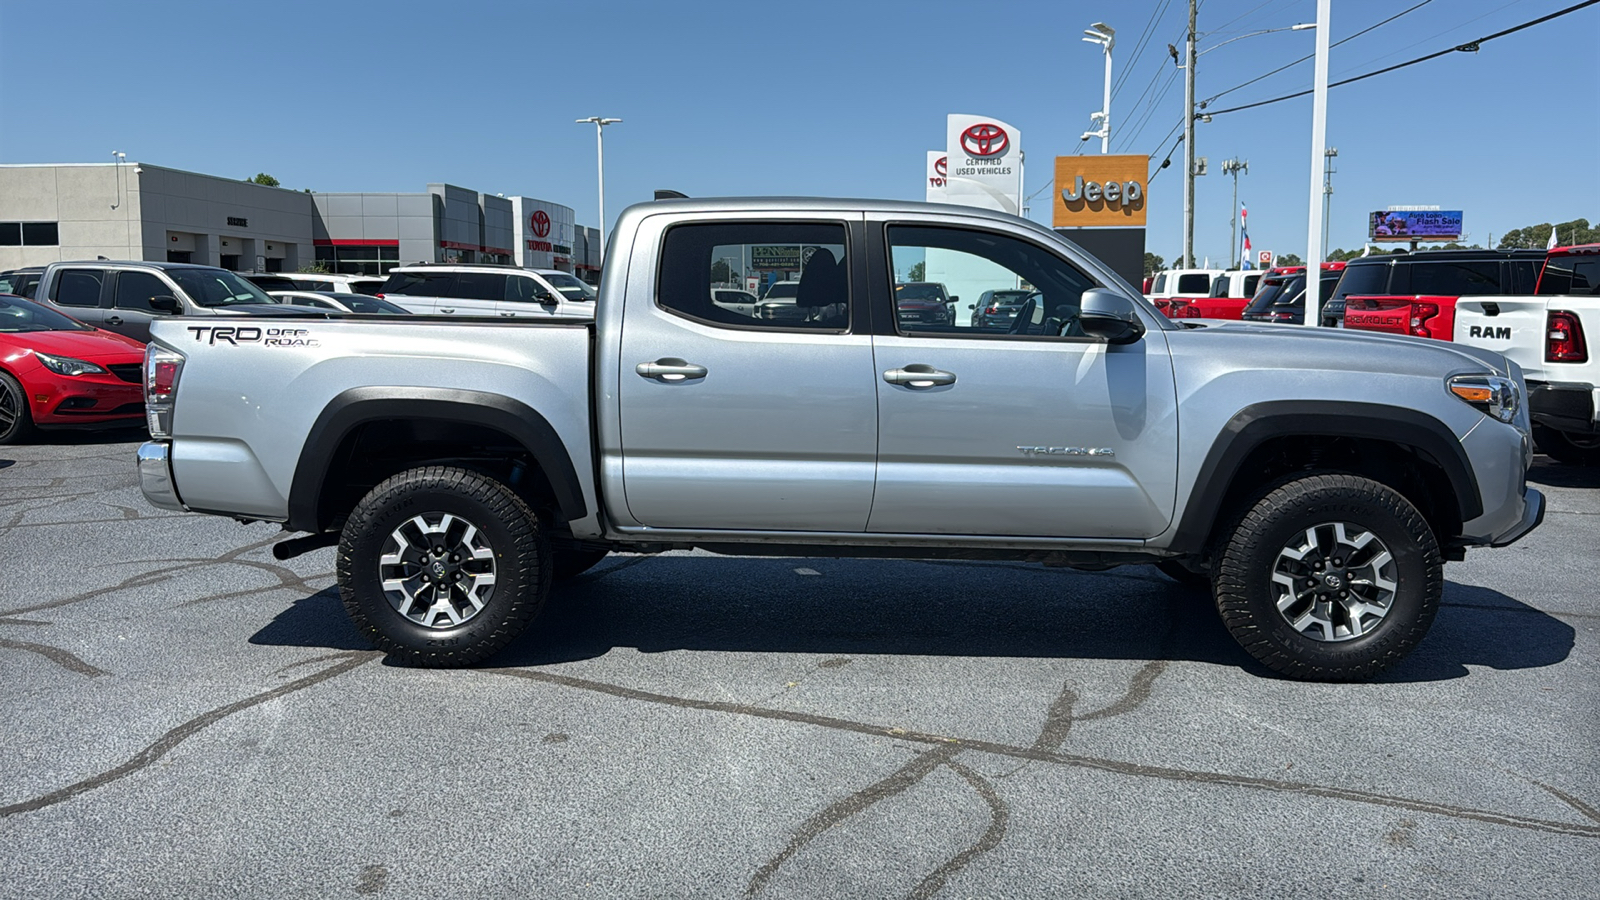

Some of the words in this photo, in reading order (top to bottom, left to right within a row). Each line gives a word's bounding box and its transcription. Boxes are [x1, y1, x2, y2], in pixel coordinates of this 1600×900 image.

[965, 158, 1002, 166] CERTIFIED
[956, 167, 976, 176] USED
[977, 167, 1012, 175] VEHICLES
[929, 178, 947, 187] TOY
[1062, 175, 1142, 206] Jeep
[1416, 217, 1440, 225] Flash
[527, 240, 553, 252] TOYOTA
[1346, 315, 1403, 325] CHEVROLET
[187, 326, 263, 346] TRD
[266, 328, 309, 337] OFF
[1469, 325, 1512, 340] RAM
[264, 338, 321, 347] ROAD
